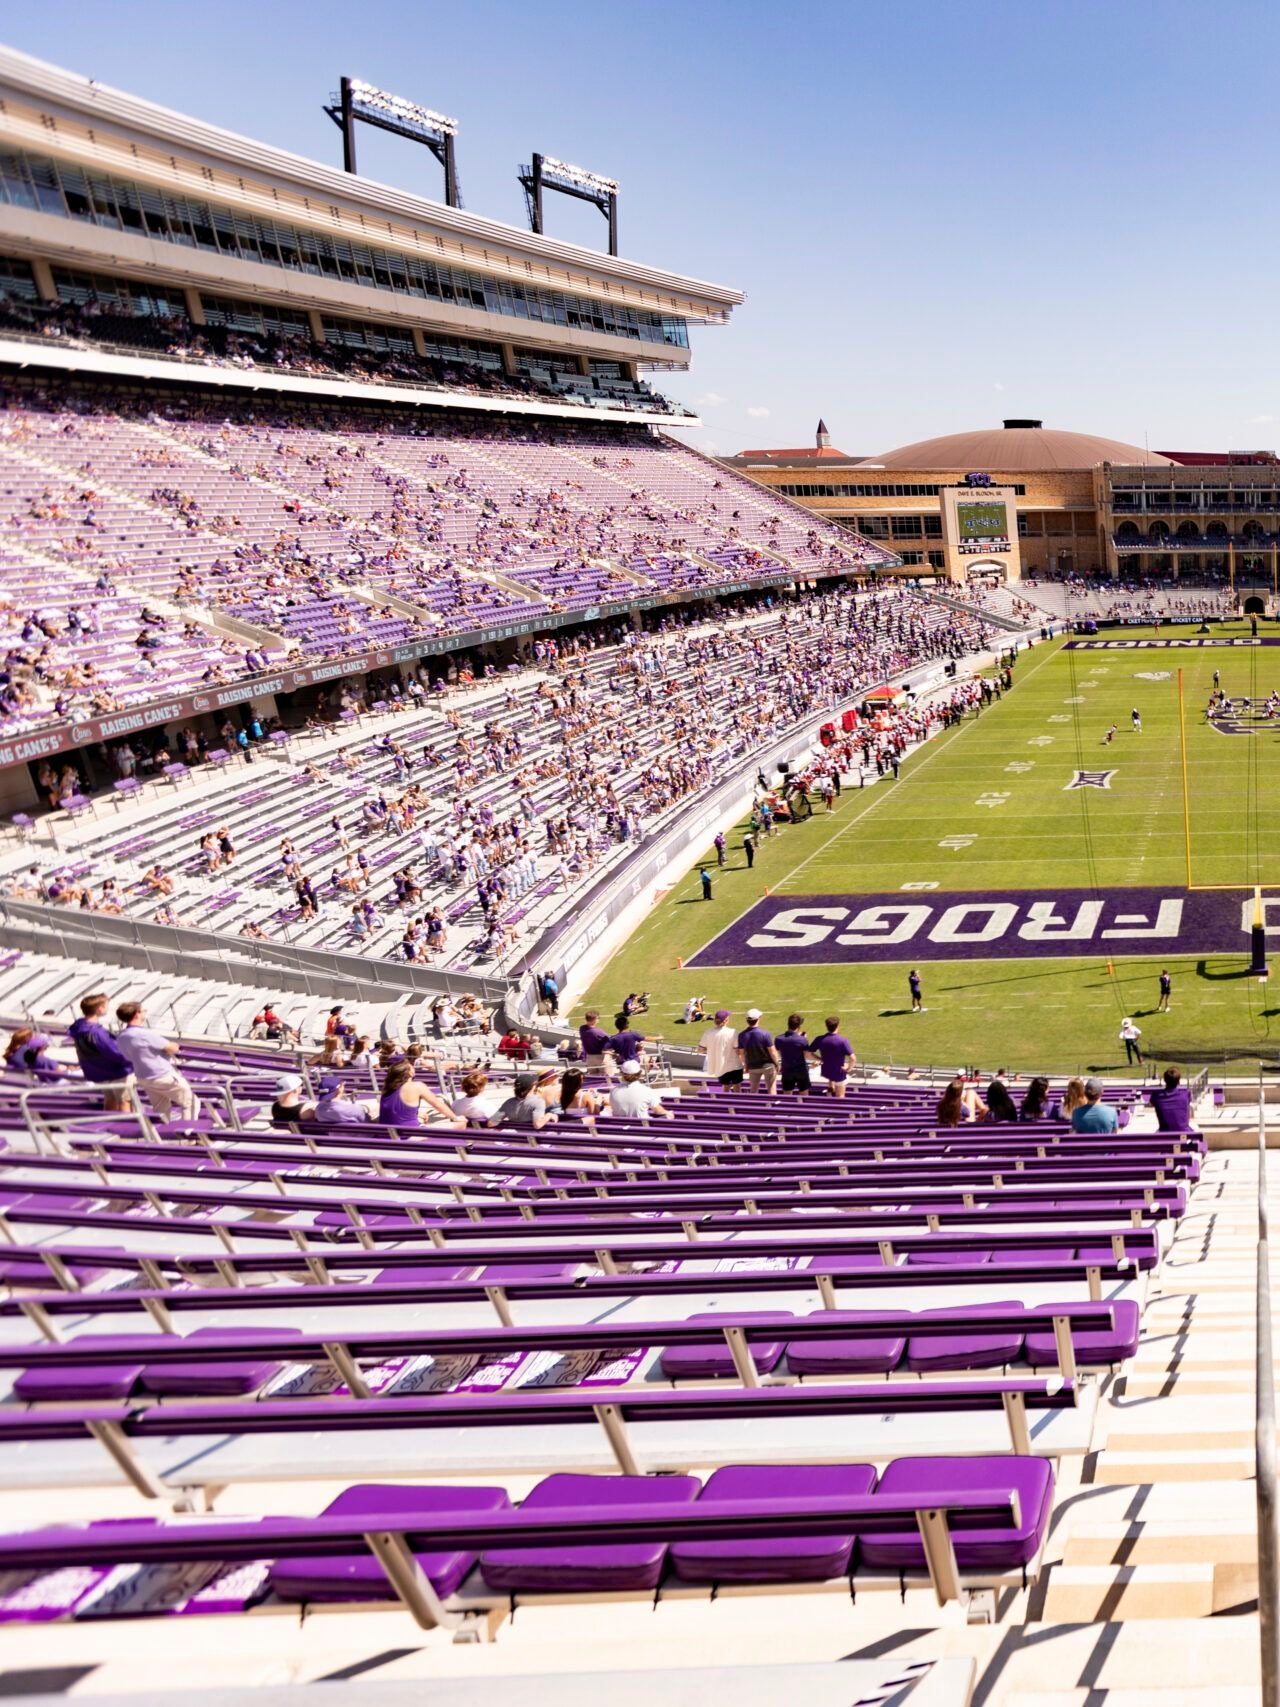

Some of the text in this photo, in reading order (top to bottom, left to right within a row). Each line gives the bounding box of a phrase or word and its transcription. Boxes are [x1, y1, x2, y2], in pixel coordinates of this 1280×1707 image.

[969, 472, 991, 487] TCU
[1075, 638, 1261, 649] HORNED
[311, 664, 342, 681] RAISING
[217, 686, 253, 705] RAISING
[99, 714, 144, 736] RAISING
[974, 791, 1011, 806] 20
[937, 833, 979, 848] 10
[746, 898, 1185, 948] FROGS
